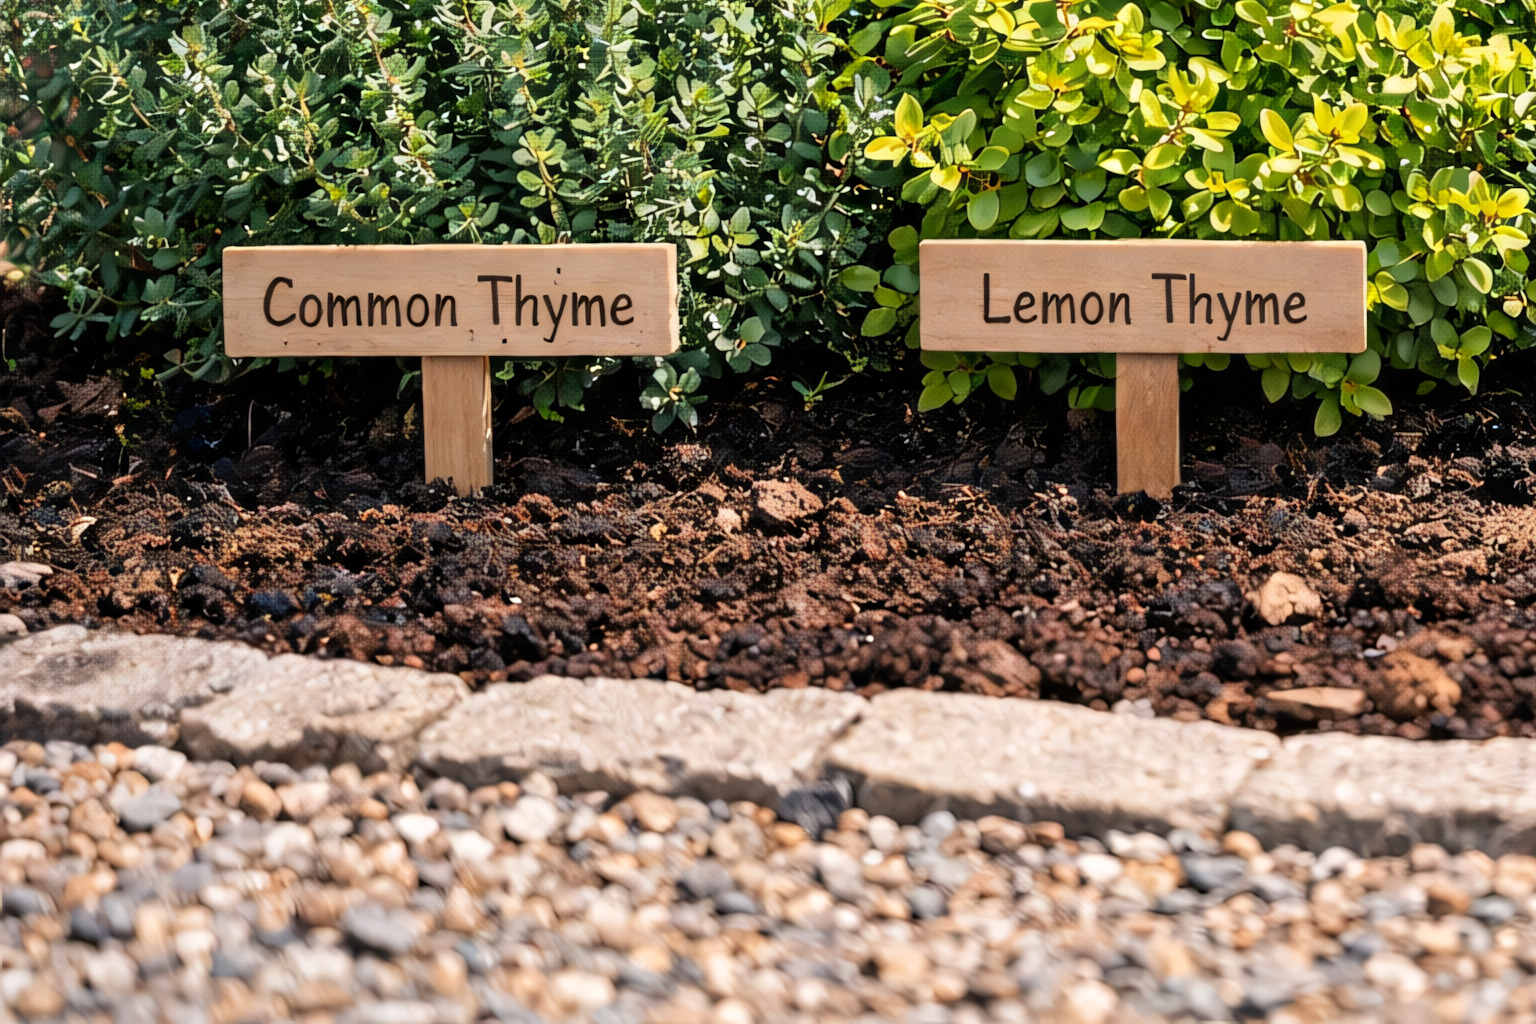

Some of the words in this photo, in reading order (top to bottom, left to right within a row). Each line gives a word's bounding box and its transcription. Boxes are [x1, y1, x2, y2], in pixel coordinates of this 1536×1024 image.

[262, 275, 459, 329] Common
[476, 272, 636, 345] Thyme
[981, 271, 1133, 326] Lemon
[1150, 271, 1309, 343] Thyme
